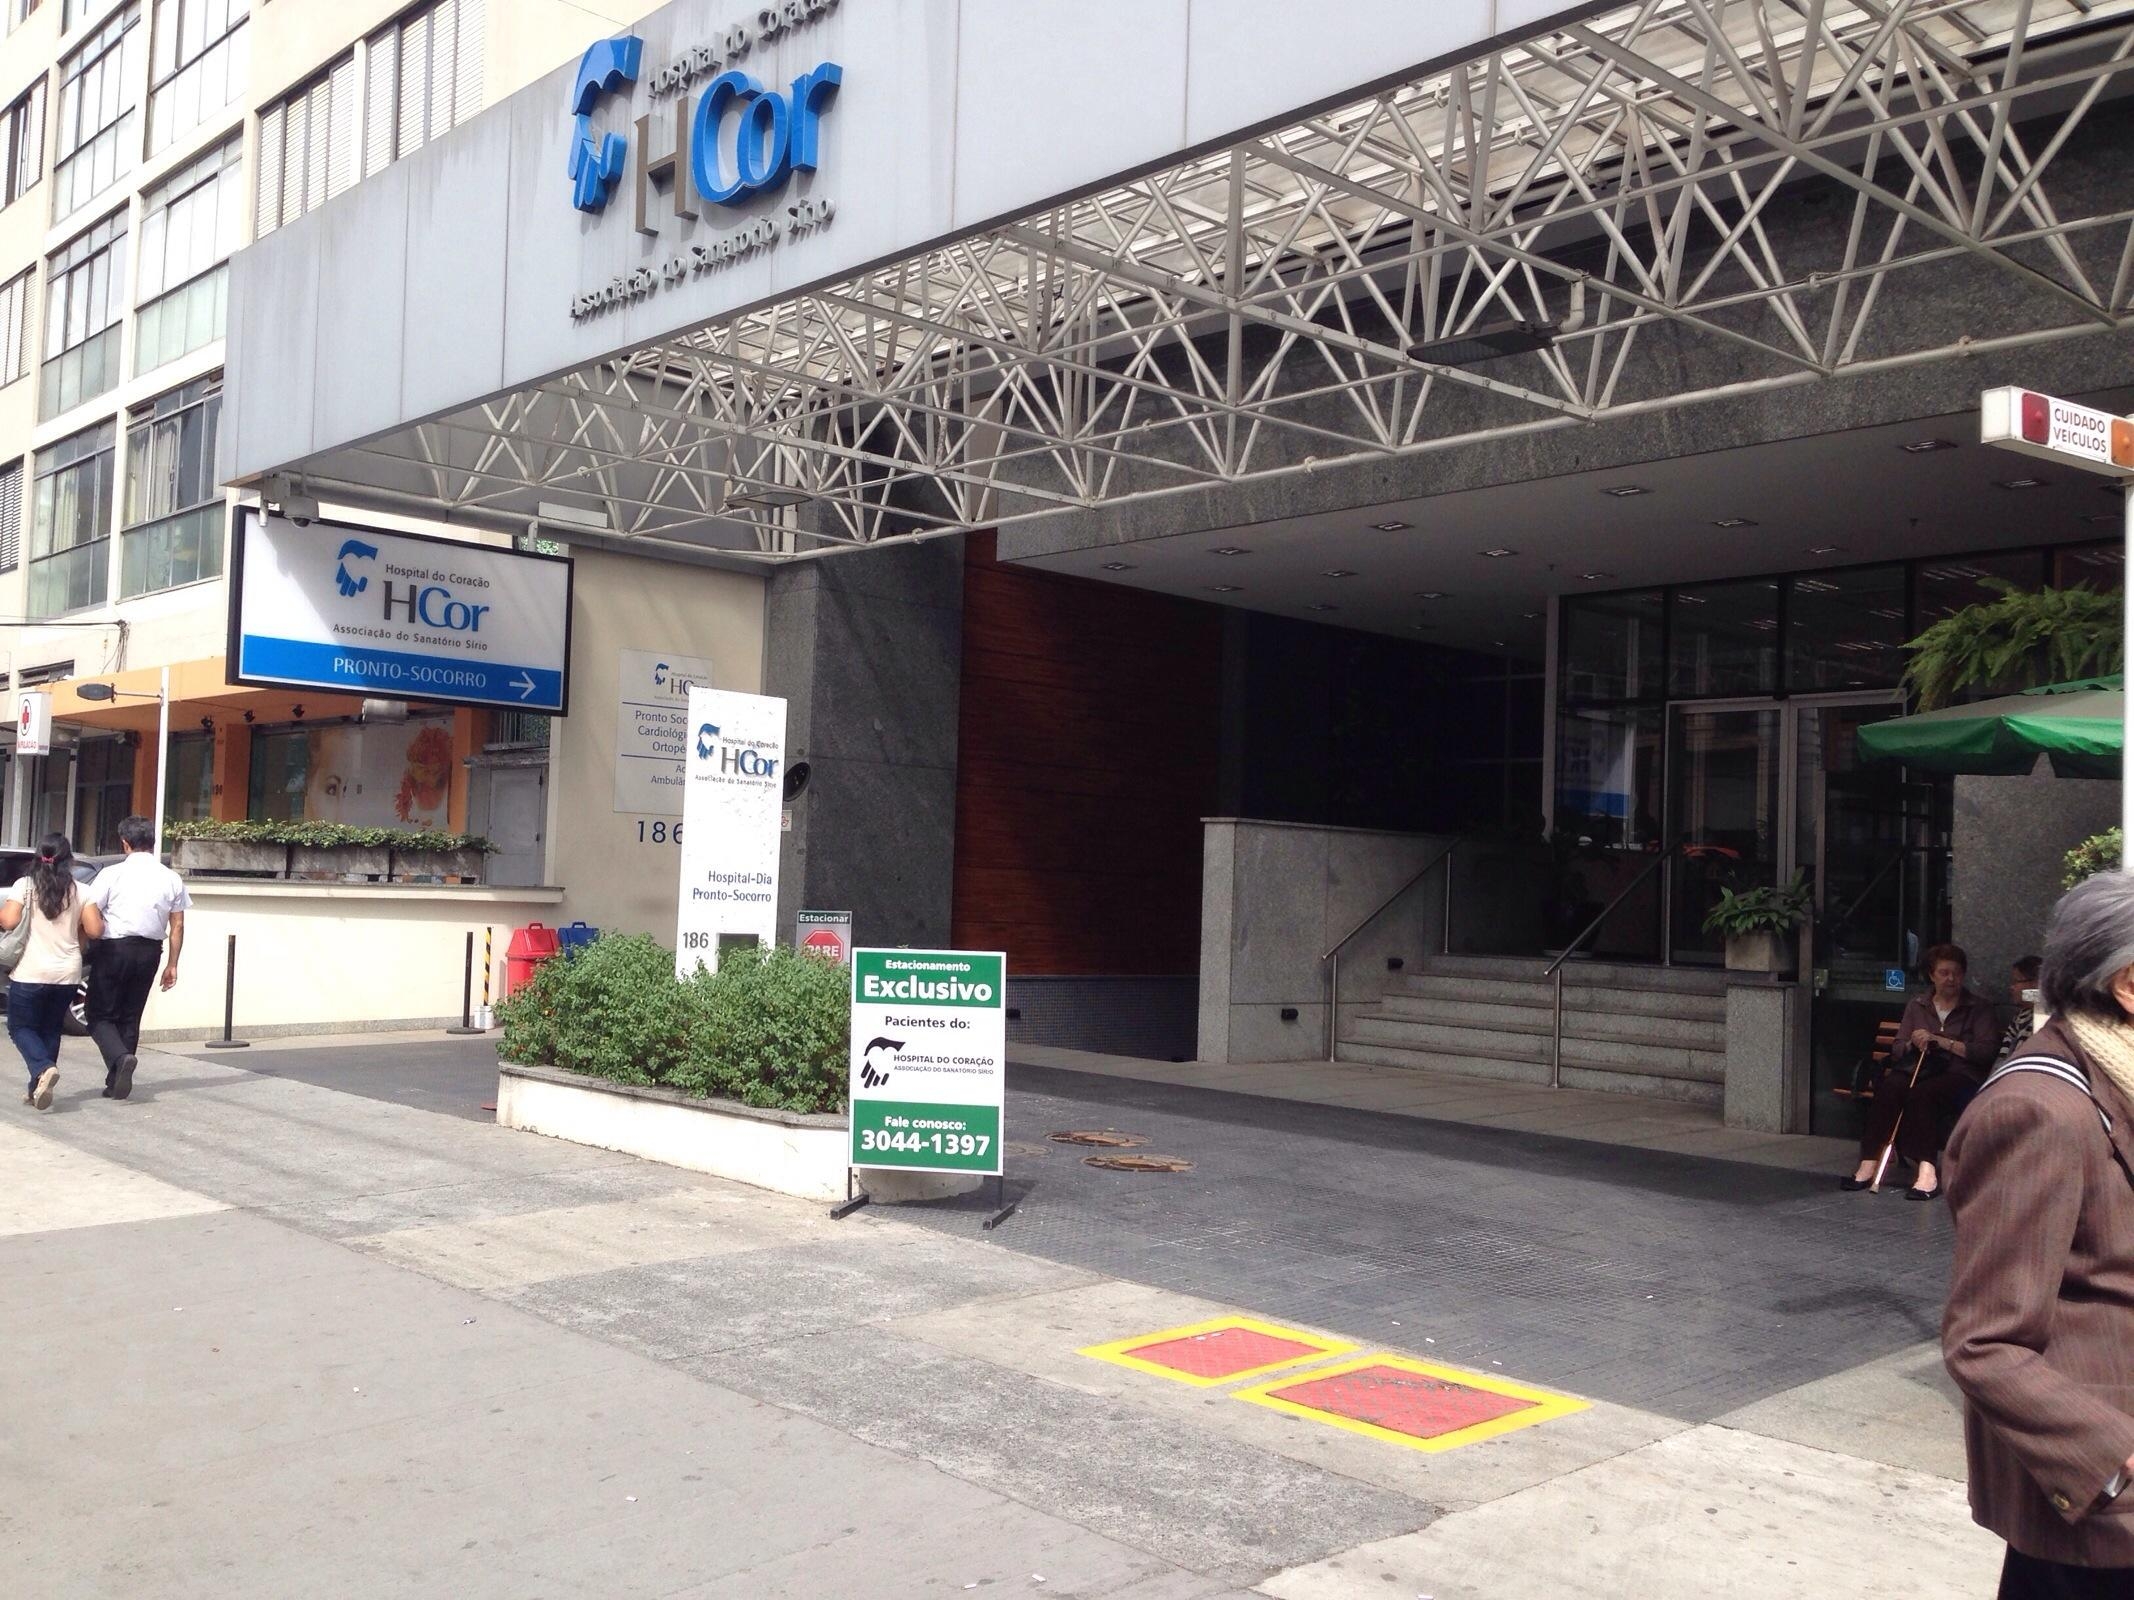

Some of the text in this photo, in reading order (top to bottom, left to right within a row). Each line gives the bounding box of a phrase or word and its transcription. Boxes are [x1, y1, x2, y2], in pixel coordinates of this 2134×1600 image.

[635, 62, 843, 237] HCor
[2054, 408, 2105, 434] CUIDADO
[2054, 426, 2106, 453] VEÍCULOS
[385, 564, 490, 588] Hospital do Coração
[383, 580, 490, 632] HCor
[333, 623, 488, 651] Associação do Sanatório Sírio
[334, 657, 487, 688] PRONTO-SOCORRO
[635, 710, 688, 724] Pronto Soc
[638, 725, 688, 741] Cardiológi
[652, 741, 686, 755] Ortopé
[721, 747, 779, 779] HCor
[650, 775, 685, 786] Ambulâ
[638, 821, 683, 845] 186
[708, 870, 772, 886] Hospital-Dia
[692, 888, 772, 902] Pronto-Socorro
[799, 914, 849, 923] Estacionar
[682, 932, 709, 949] 186
[885, 959, 971, 972] Estacionamento
[864, 975, 993, 1001] Exclusivo
[885, 1015, 971, 1029] Pacientes do:
[893, 1054, 994, 1067] HOSPITAL DO CORAÇÃO
[893, 1064, 932, 1072] ASSOCIAÇÃO
[885, 1116, 966, 1131] Fale conosco:
[861, 1129, 990, 1156] 3044-1397
